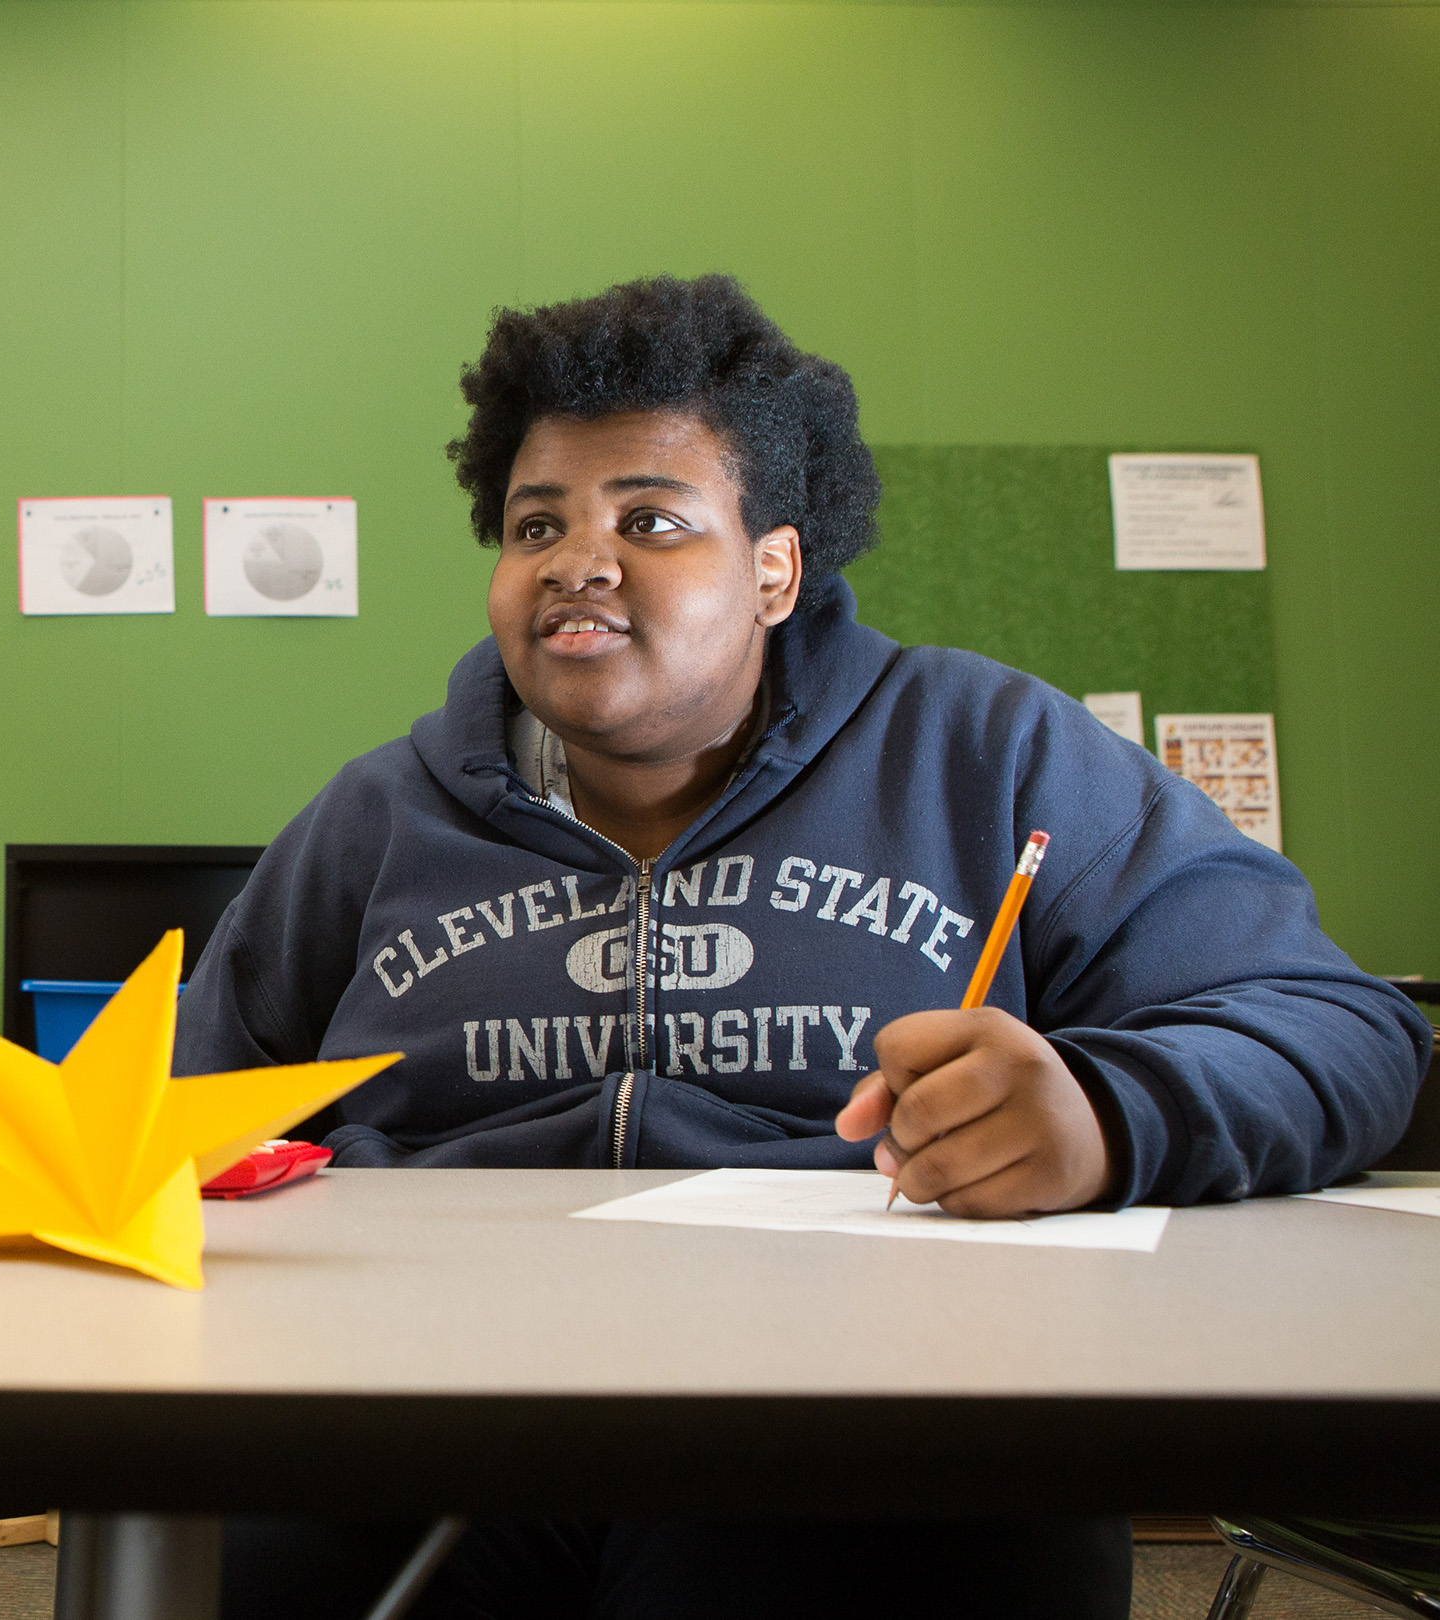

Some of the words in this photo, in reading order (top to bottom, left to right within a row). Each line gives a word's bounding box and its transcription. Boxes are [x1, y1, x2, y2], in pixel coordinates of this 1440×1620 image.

[373, 854, 755, 997] CLEVELAND
[770, 856, 975, 973] STATE
[601, 933, 720, 980] CSU
[464, 1006, 871, 1082] UNIVERSITY
